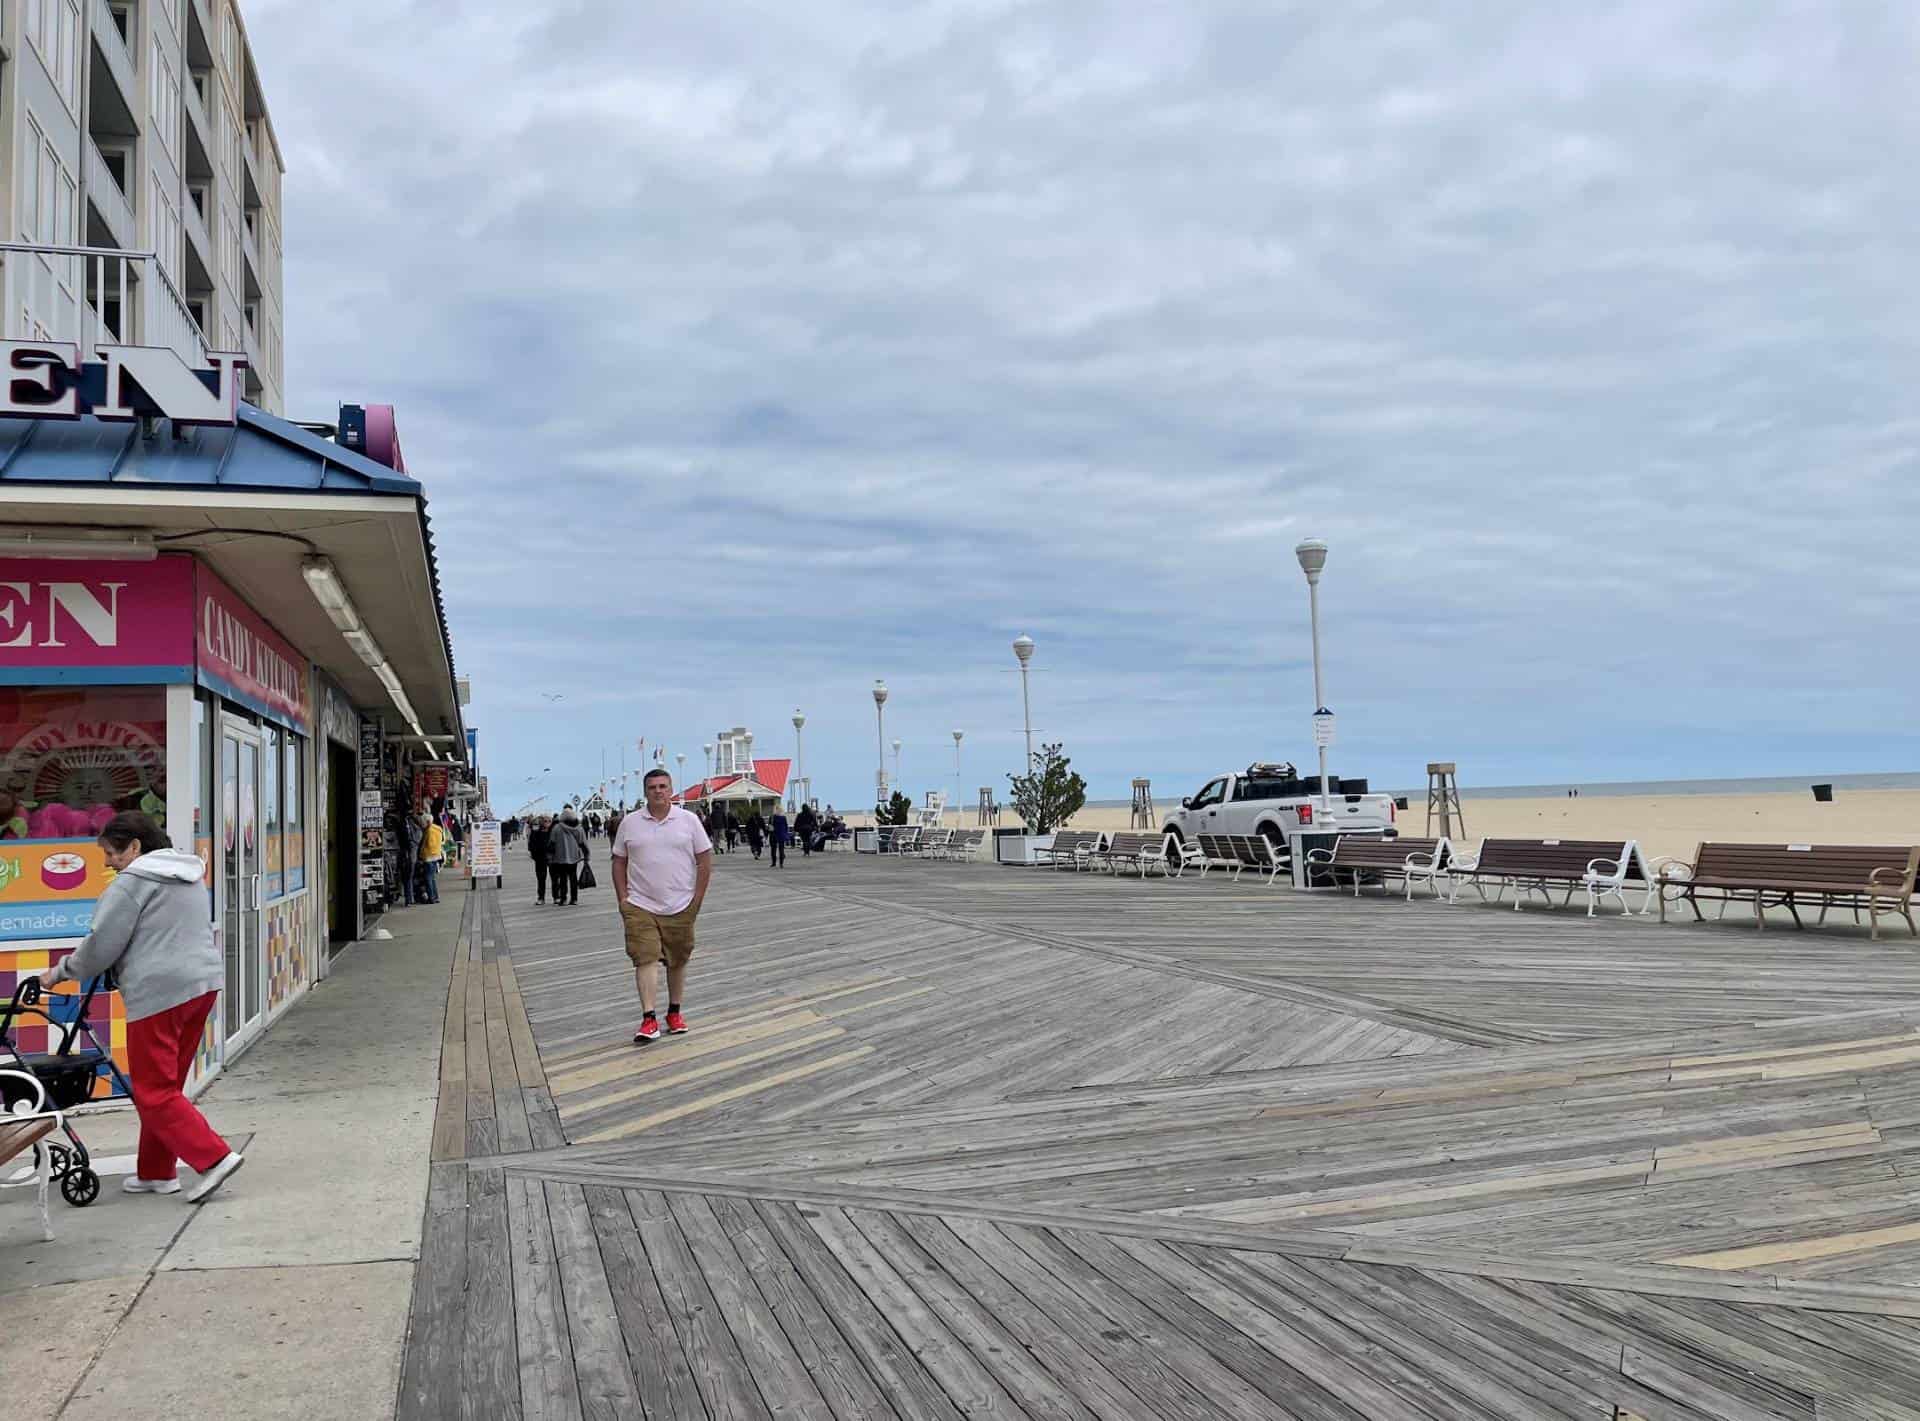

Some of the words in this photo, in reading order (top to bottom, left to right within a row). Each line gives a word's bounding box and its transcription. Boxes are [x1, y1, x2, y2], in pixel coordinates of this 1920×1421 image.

[0, 339, 248, 426] EN
[204, 596, 252, 679] CANDY
[255, 637, 300, 709] KITCHEN
[0, 911, 67, 930] emade
